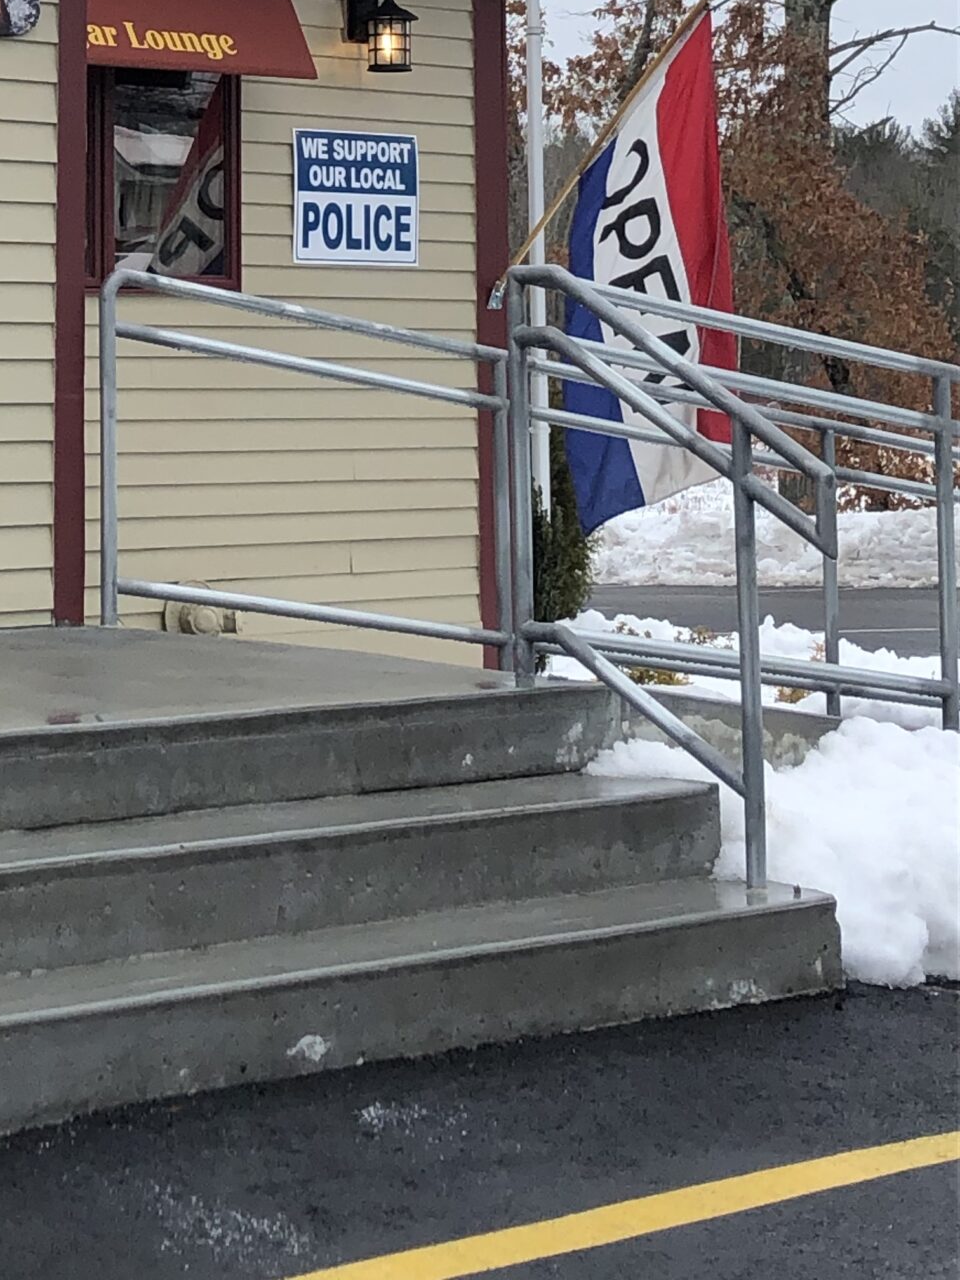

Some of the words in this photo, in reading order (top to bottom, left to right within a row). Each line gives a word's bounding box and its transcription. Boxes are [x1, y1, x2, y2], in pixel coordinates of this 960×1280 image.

[86, 24, 117, 49] ar
[123, 21, 237, 60] Lounge
[301, 137, 329, 160] WE
[333, 138, 411, 164] SUPPORT
[309, 165, 347, 188] OUR
[351, 167, 406, 191] LOCAL
[302, 202, 412, 252] POLICE
